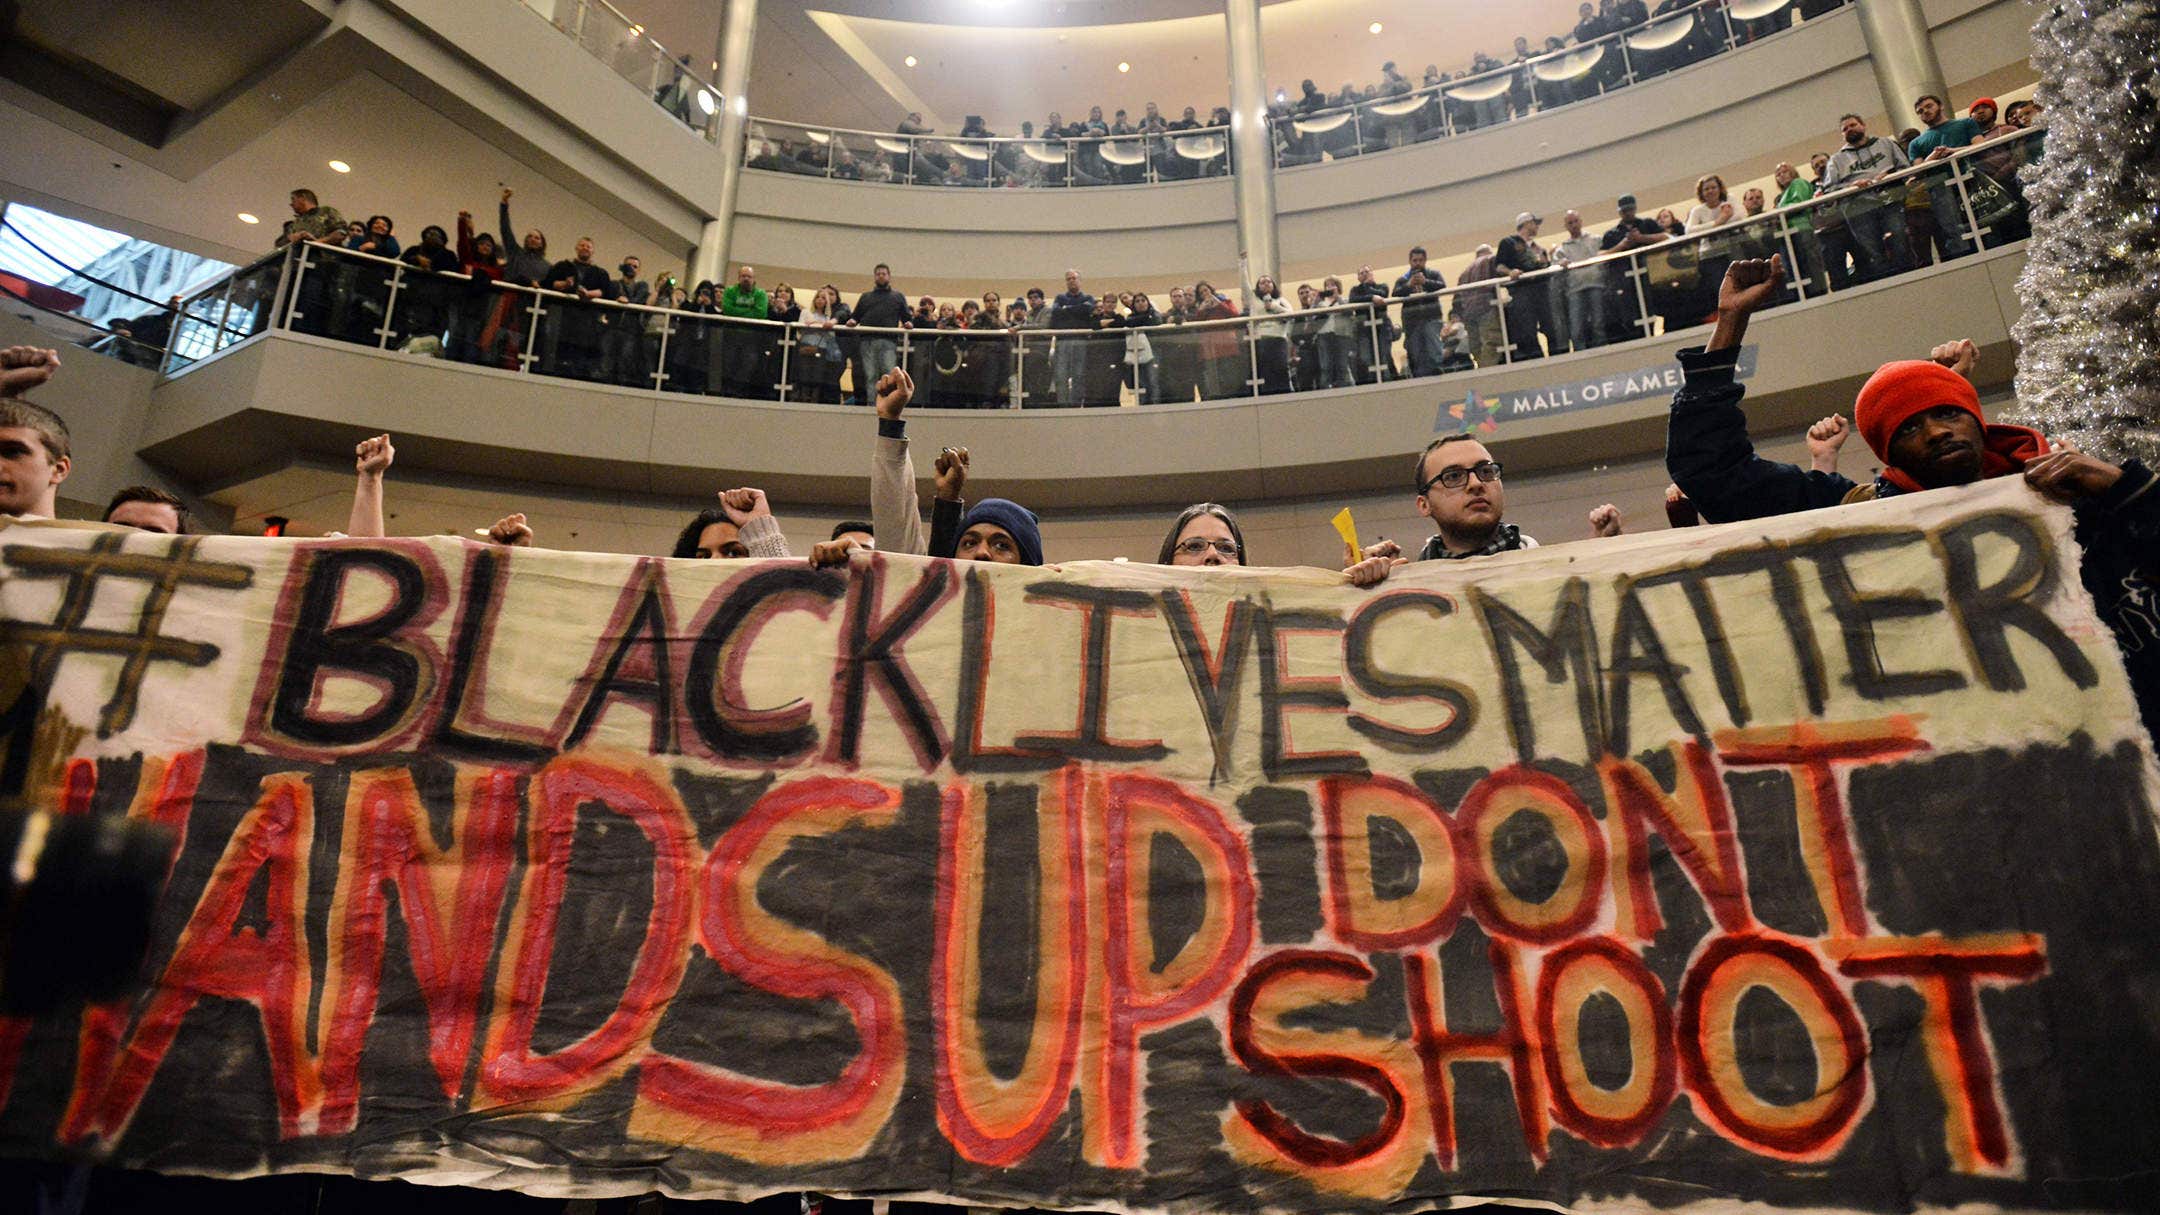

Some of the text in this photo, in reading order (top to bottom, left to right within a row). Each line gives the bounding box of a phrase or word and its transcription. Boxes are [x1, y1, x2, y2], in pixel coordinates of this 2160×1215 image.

[1513, 389, 1574, 414] MALL
[1582, 381, 1613, 402] OF
[1318, 712, 1932, 955] DONT
[1222, 930, 2052, 1198] SHOOT
